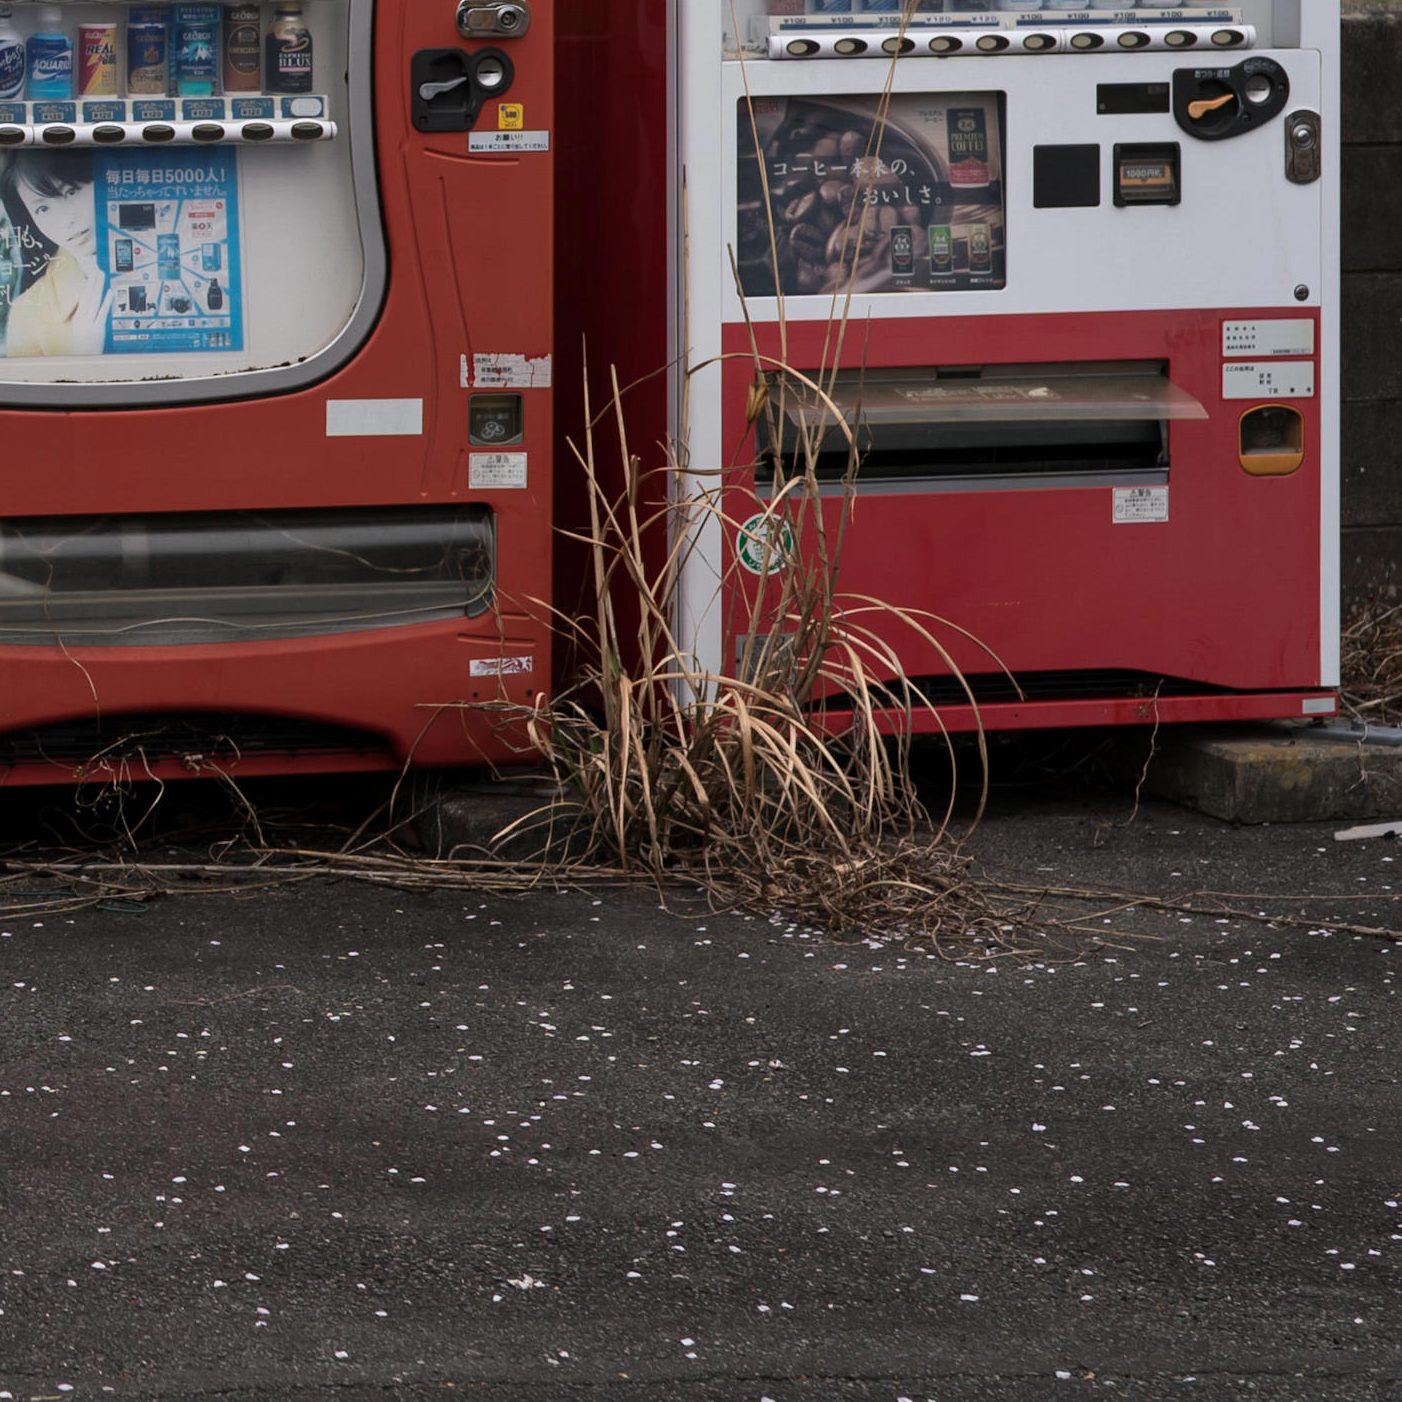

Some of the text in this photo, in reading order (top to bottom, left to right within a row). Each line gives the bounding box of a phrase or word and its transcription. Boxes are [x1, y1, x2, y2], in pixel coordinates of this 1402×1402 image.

[86, 44, 114, 55] REAL
[773, 158, 916, 177] コーヒー本来の、
[862, 185, 943, 205] おいしさ。
